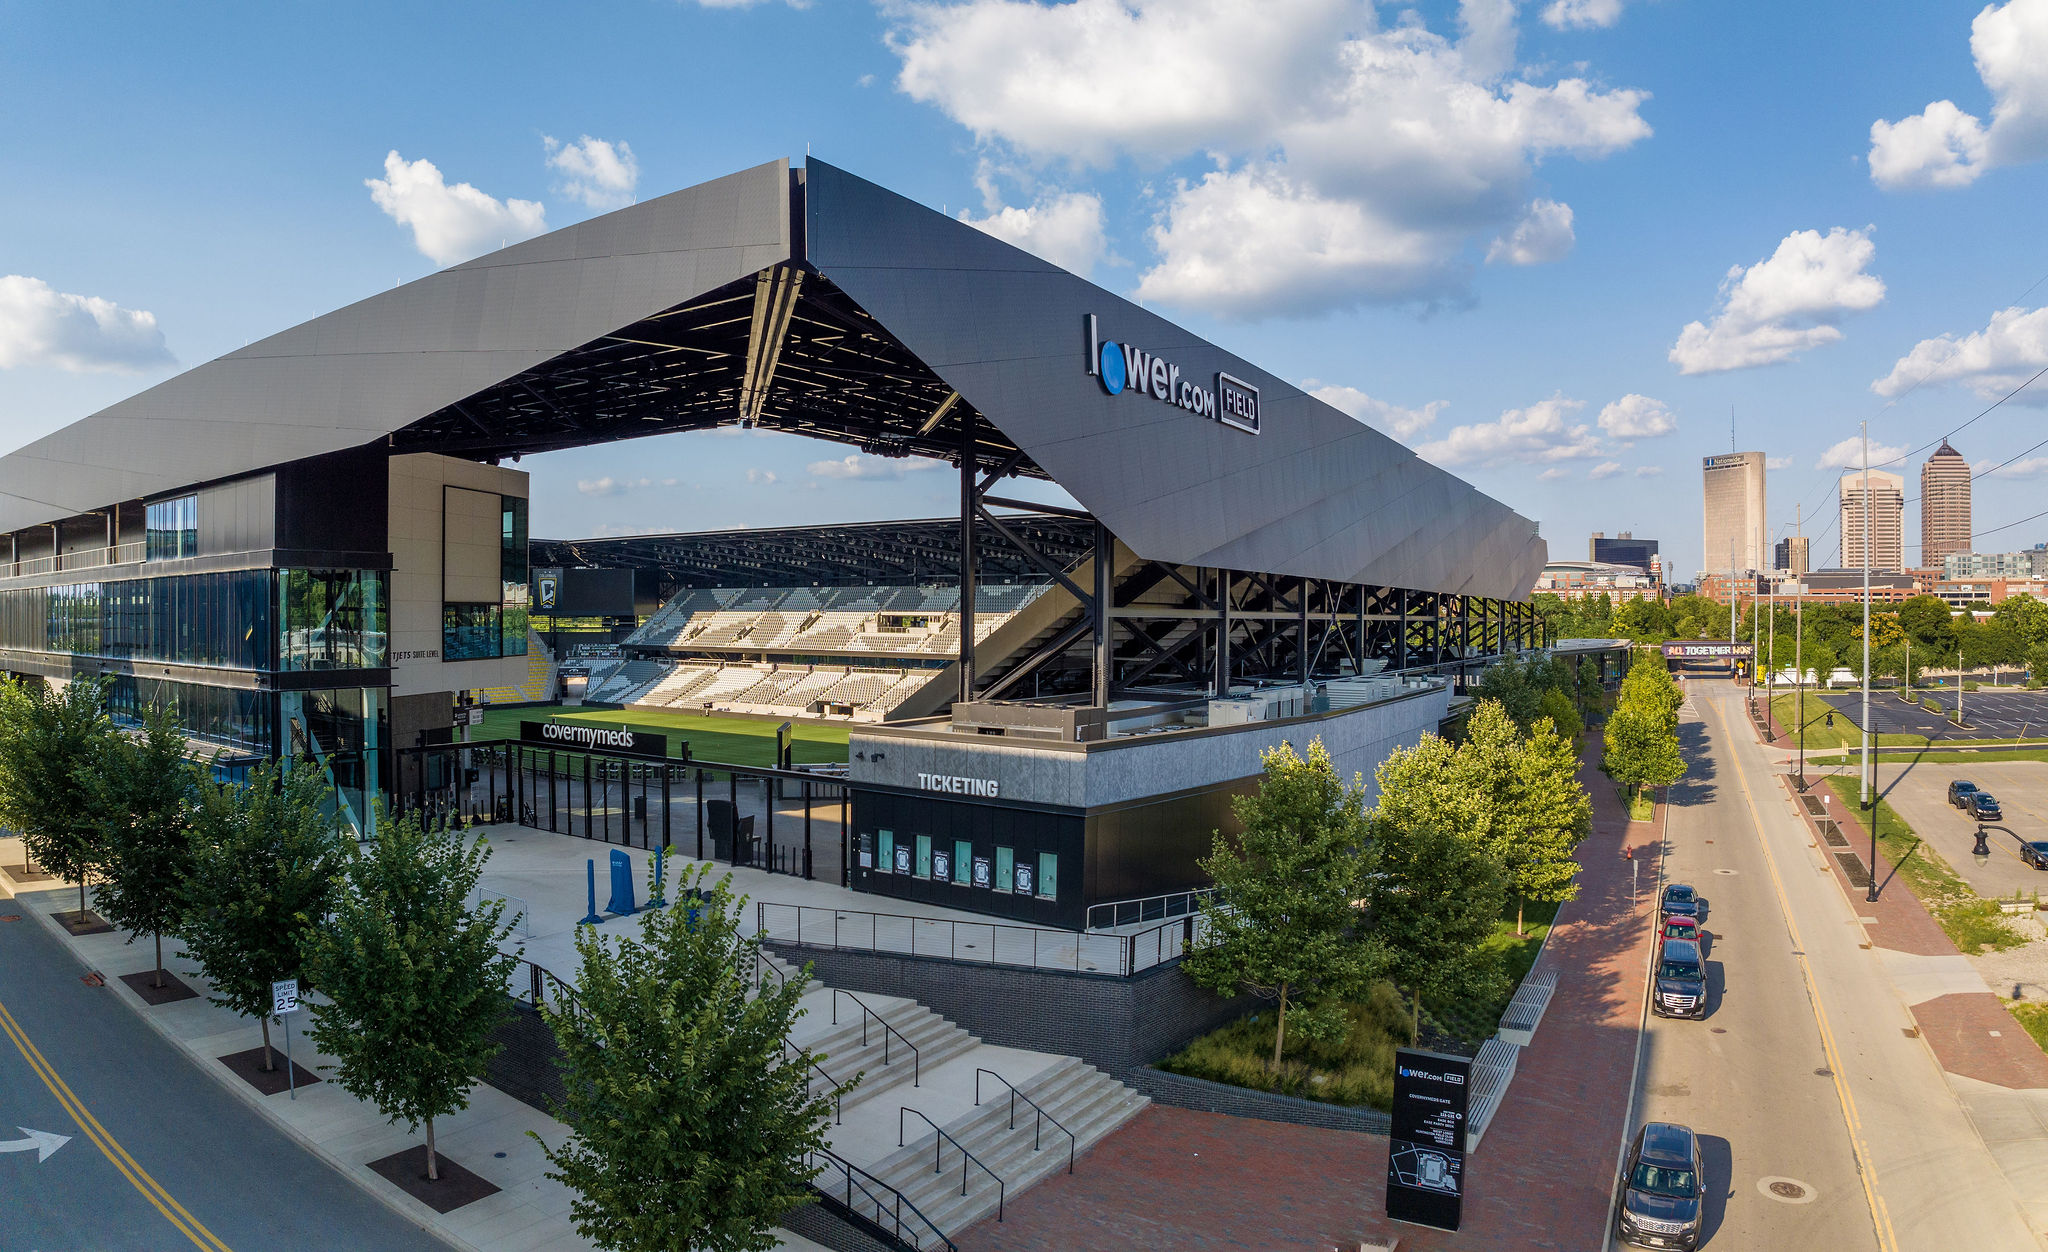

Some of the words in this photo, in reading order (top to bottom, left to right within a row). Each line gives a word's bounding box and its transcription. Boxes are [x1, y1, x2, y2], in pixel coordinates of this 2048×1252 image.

[1226, 388, 1255, 420] FIELD
[391, 651, 411, 662] TJETS
[412, 650, 426, 659] SUITE
[426, 650, 440, 658] LEVEL
[1685, 646, 1731, 655] TOGETHER
[542, 723, 634, 749] covermymeds
[918, 772, 999, 798] TICKETING
[275, 983, 295, 991] SPEED
[277, 990, 293, 998] LIMIT
[276, 996, 296, 1010] 25
